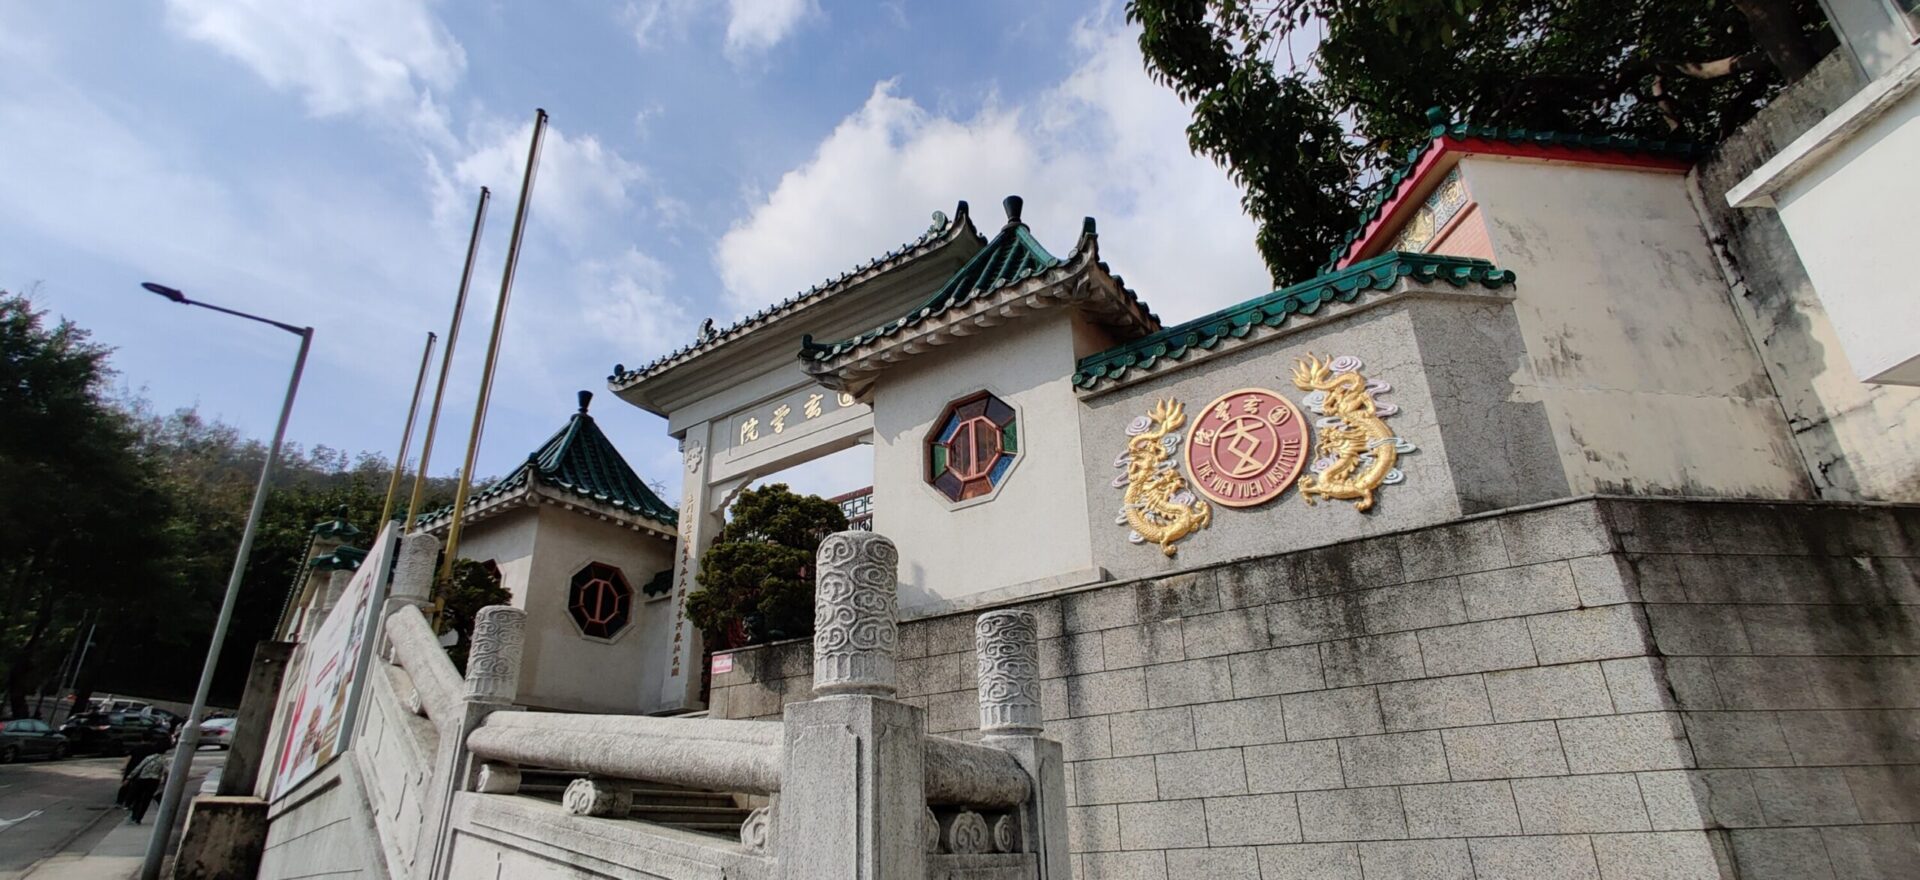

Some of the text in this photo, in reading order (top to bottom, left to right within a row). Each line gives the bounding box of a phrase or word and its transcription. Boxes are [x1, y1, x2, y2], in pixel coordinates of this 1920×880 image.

[1197, 438, 1300, 499] THE YUEN YUEN INSTITUTE
